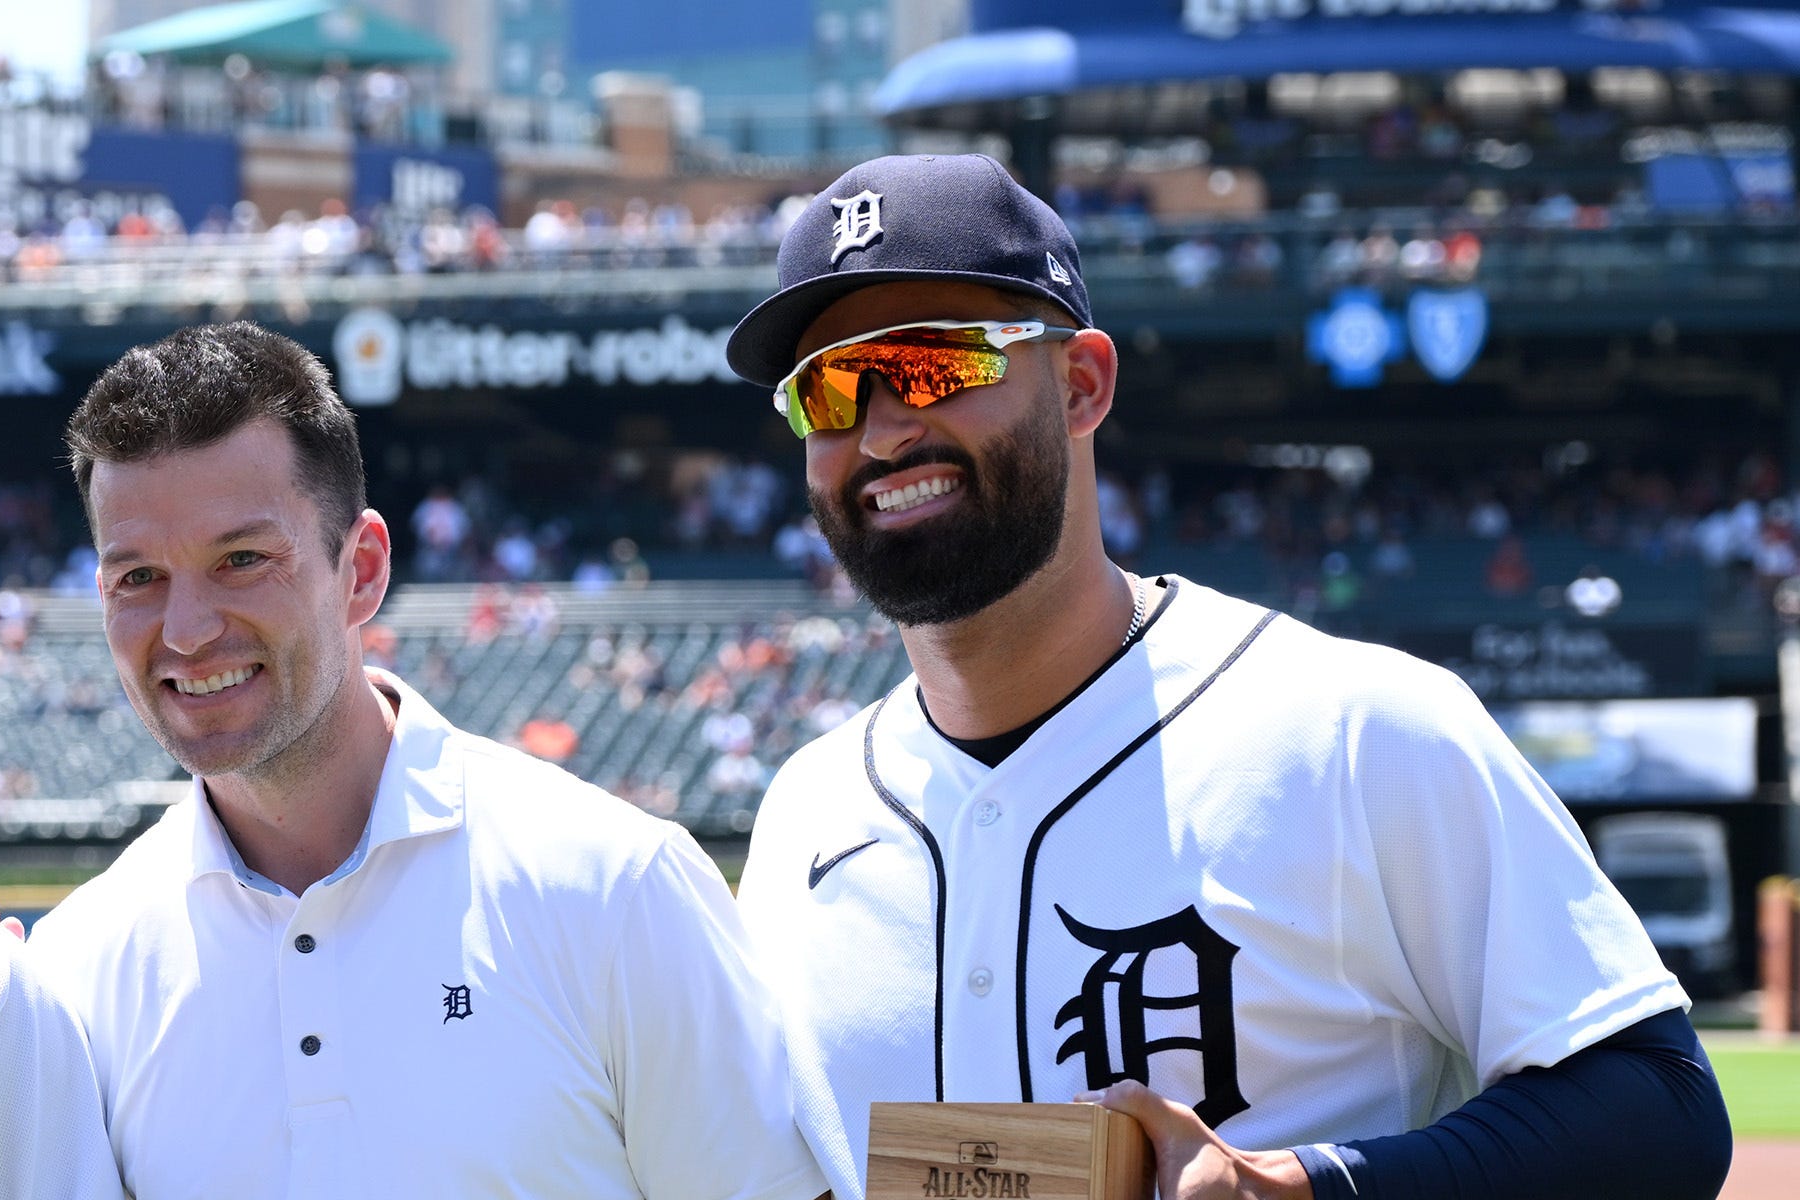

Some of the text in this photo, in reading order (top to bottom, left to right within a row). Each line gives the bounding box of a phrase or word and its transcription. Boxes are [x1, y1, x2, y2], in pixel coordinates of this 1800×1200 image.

[830, 189, 884, 265] D
[441, 983, 474, 1025] D
[1054, 904, 1251, 1131] D
